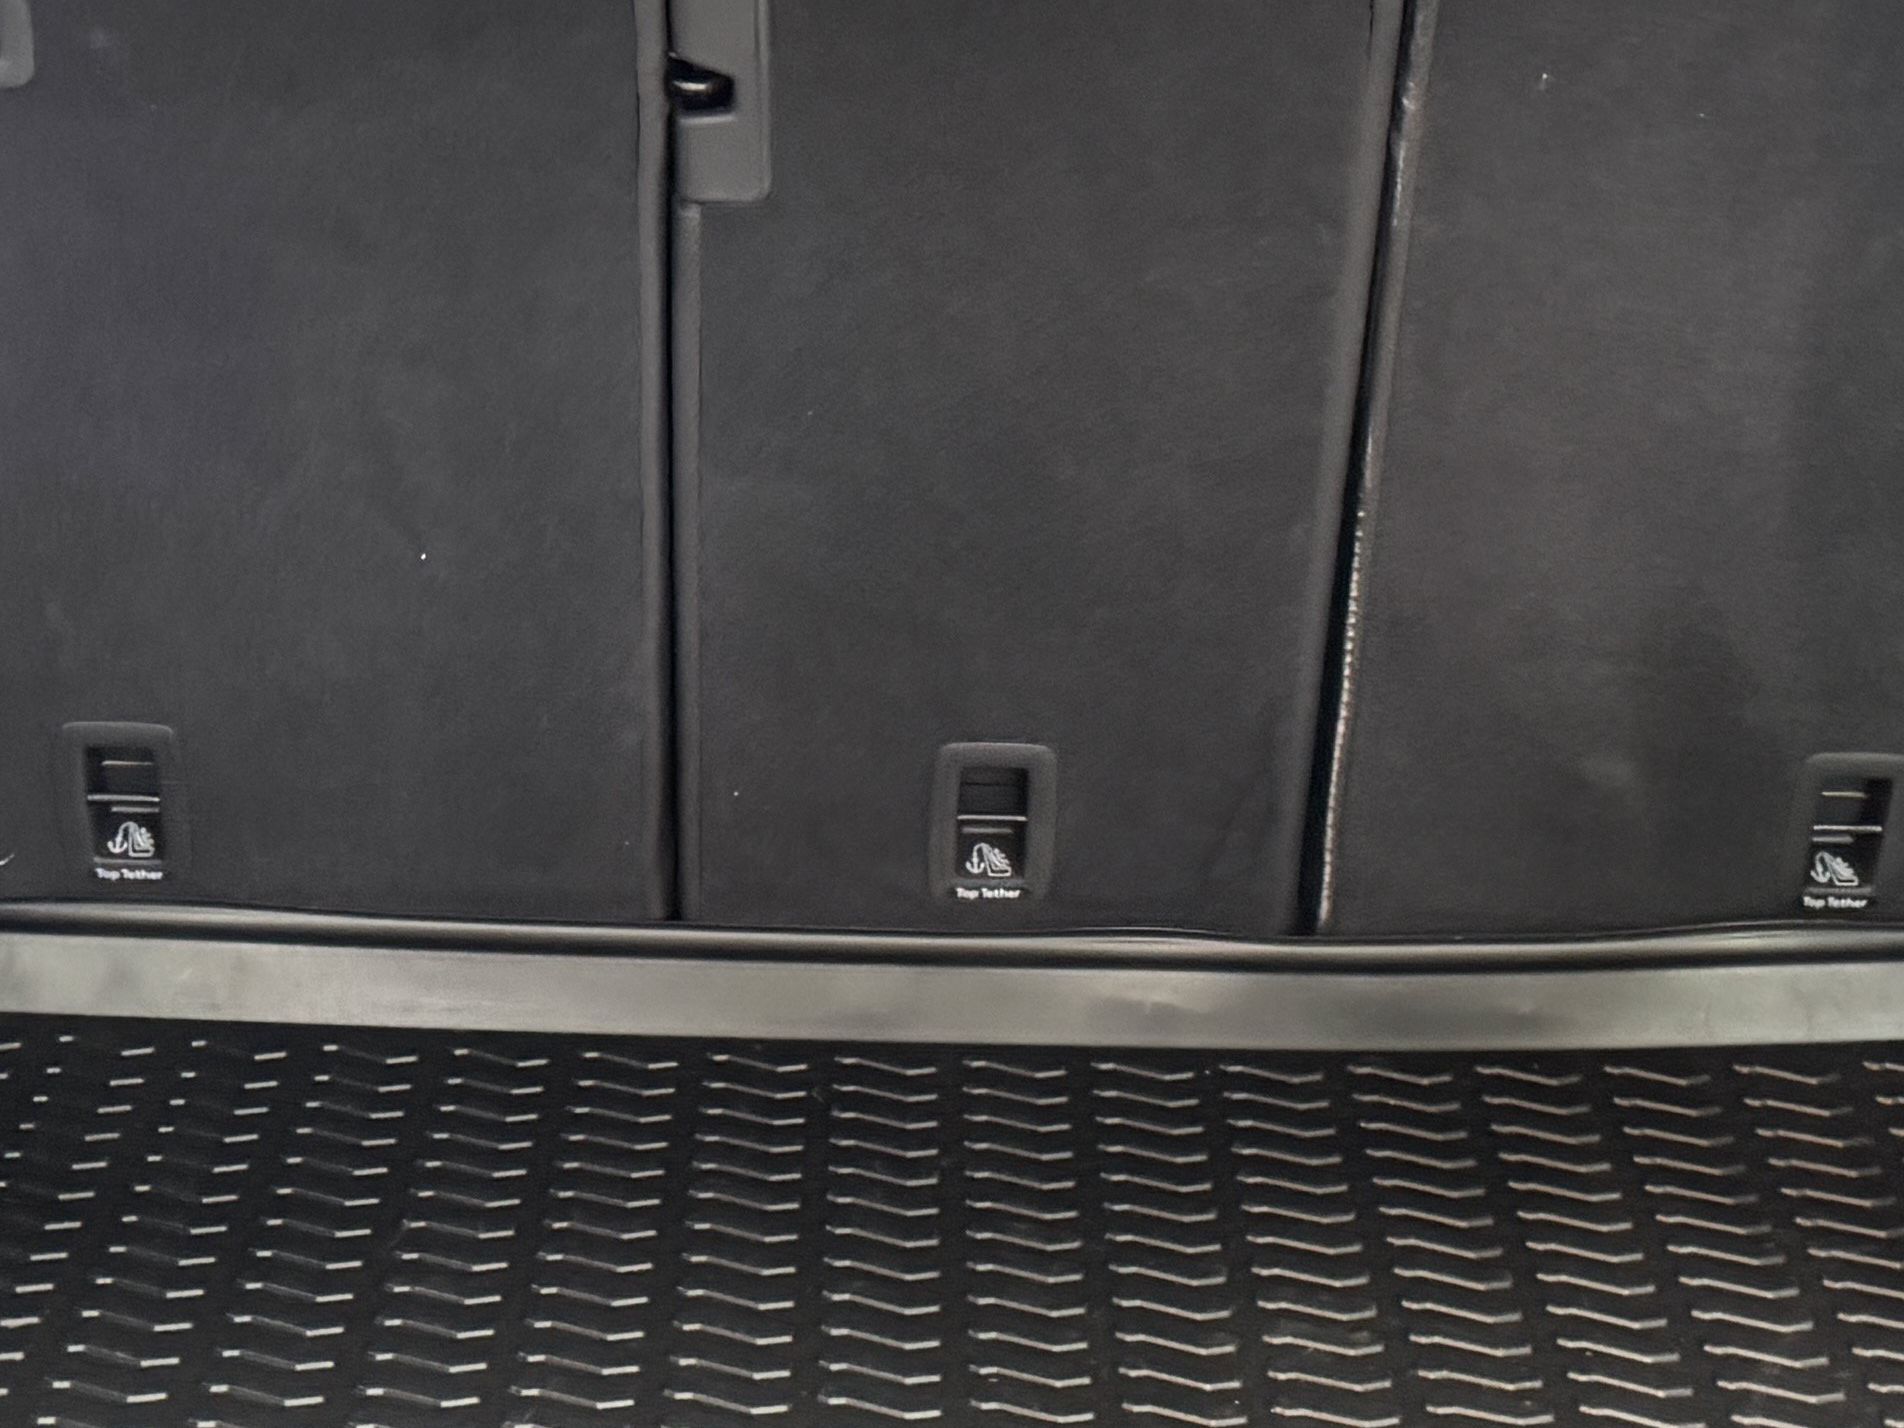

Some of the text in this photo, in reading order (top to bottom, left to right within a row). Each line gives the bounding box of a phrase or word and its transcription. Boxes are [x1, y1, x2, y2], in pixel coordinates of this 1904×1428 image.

[95, 868, 163, 882] Top Tether
[956, 888, 1020, 900] Top Tether
[1803, 896, 1868, 910] Top Tether
